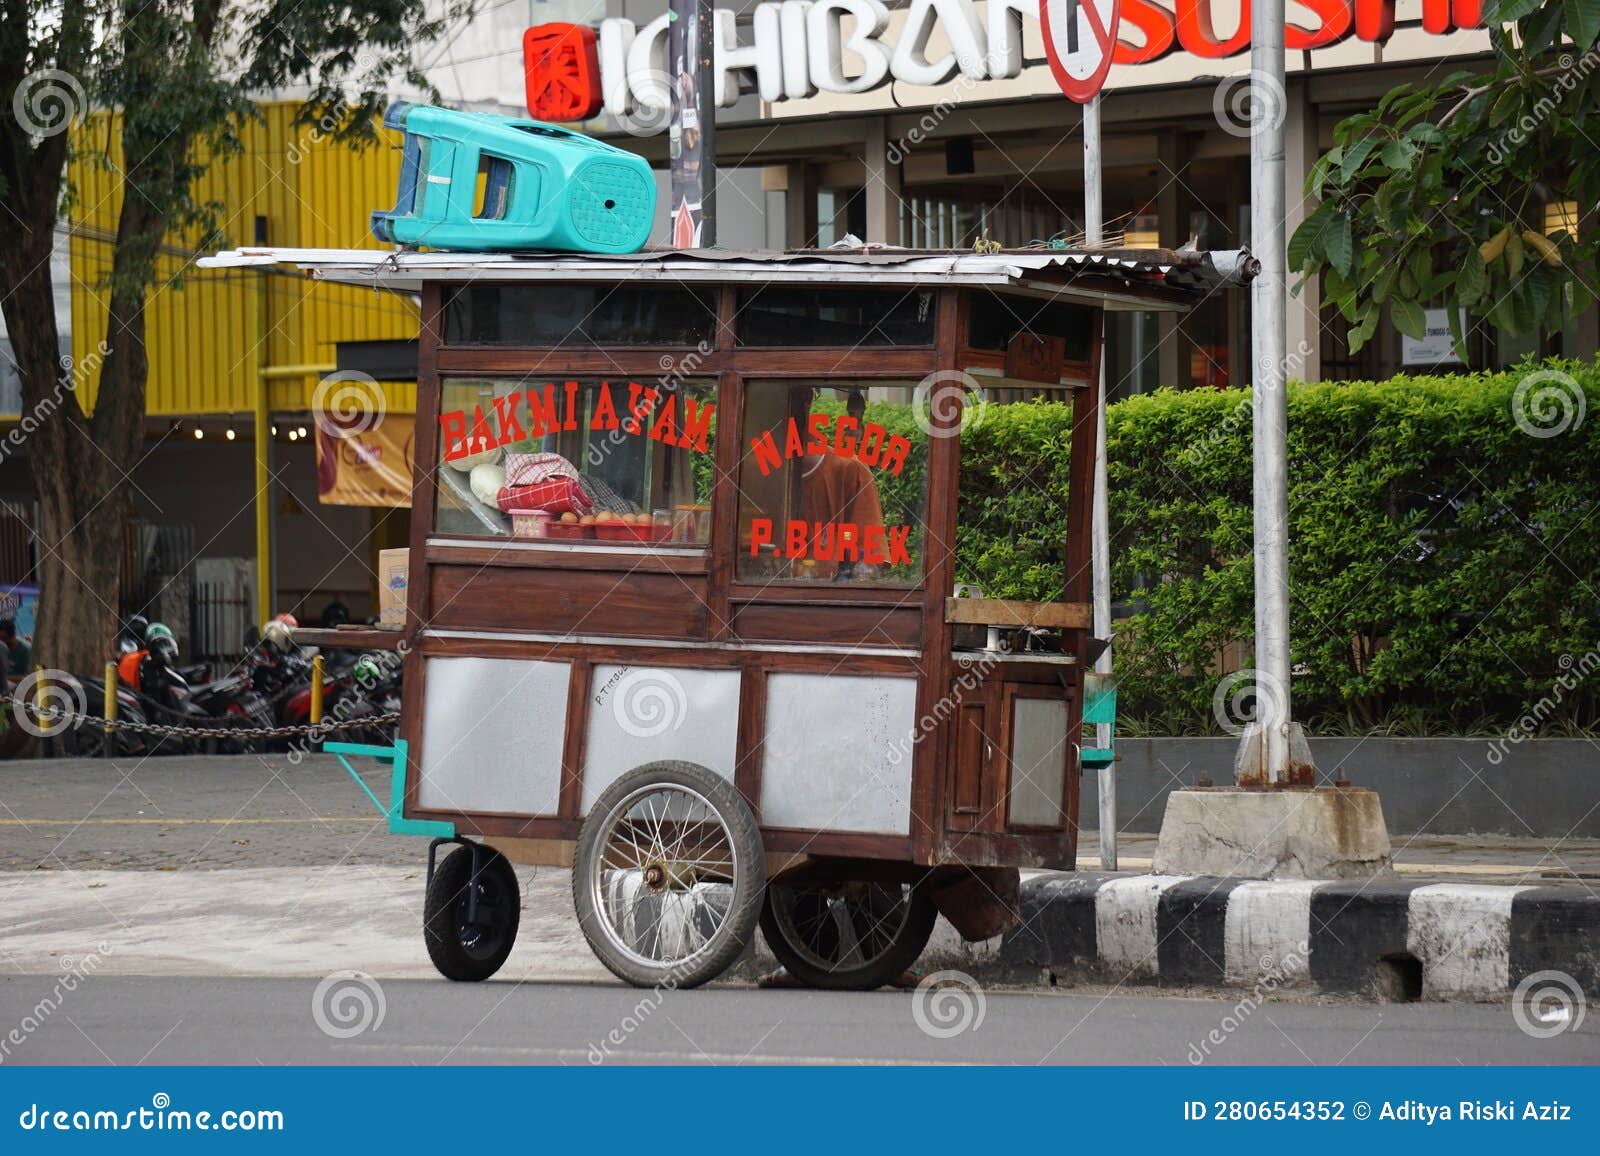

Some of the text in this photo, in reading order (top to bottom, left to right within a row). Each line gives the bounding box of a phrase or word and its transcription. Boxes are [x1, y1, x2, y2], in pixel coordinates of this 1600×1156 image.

[439, 380, 579, 463] BAKMI
[589, 380, 716, 454] AYAM
[751, 413, 912, 477] NASGOR
[750, 518, 912, 566] P.BUREK
